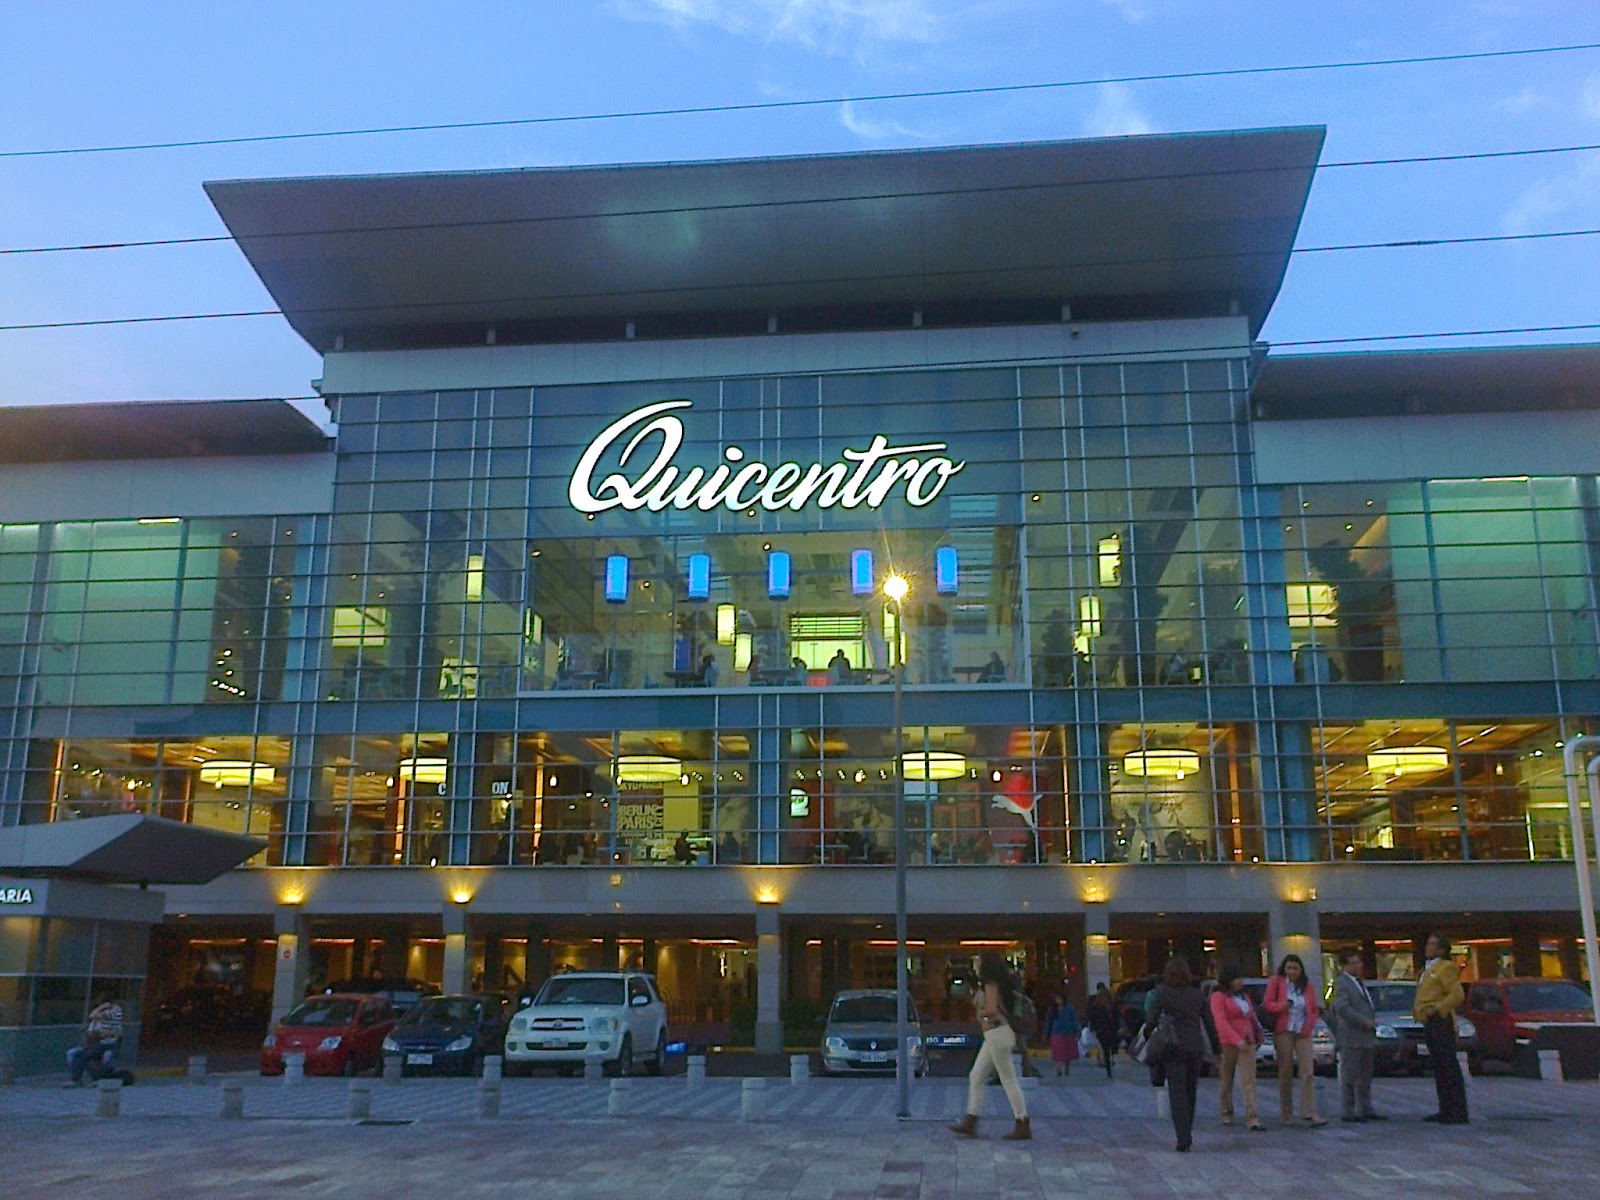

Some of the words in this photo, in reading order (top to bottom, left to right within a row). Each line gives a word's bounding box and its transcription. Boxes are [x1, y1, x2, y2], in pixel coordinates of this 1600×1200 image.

[568, 399, 966, 513] Quicentro
[619, 804, 655, 816] BERLIN
[619, 816, 654, 830] PARIS
